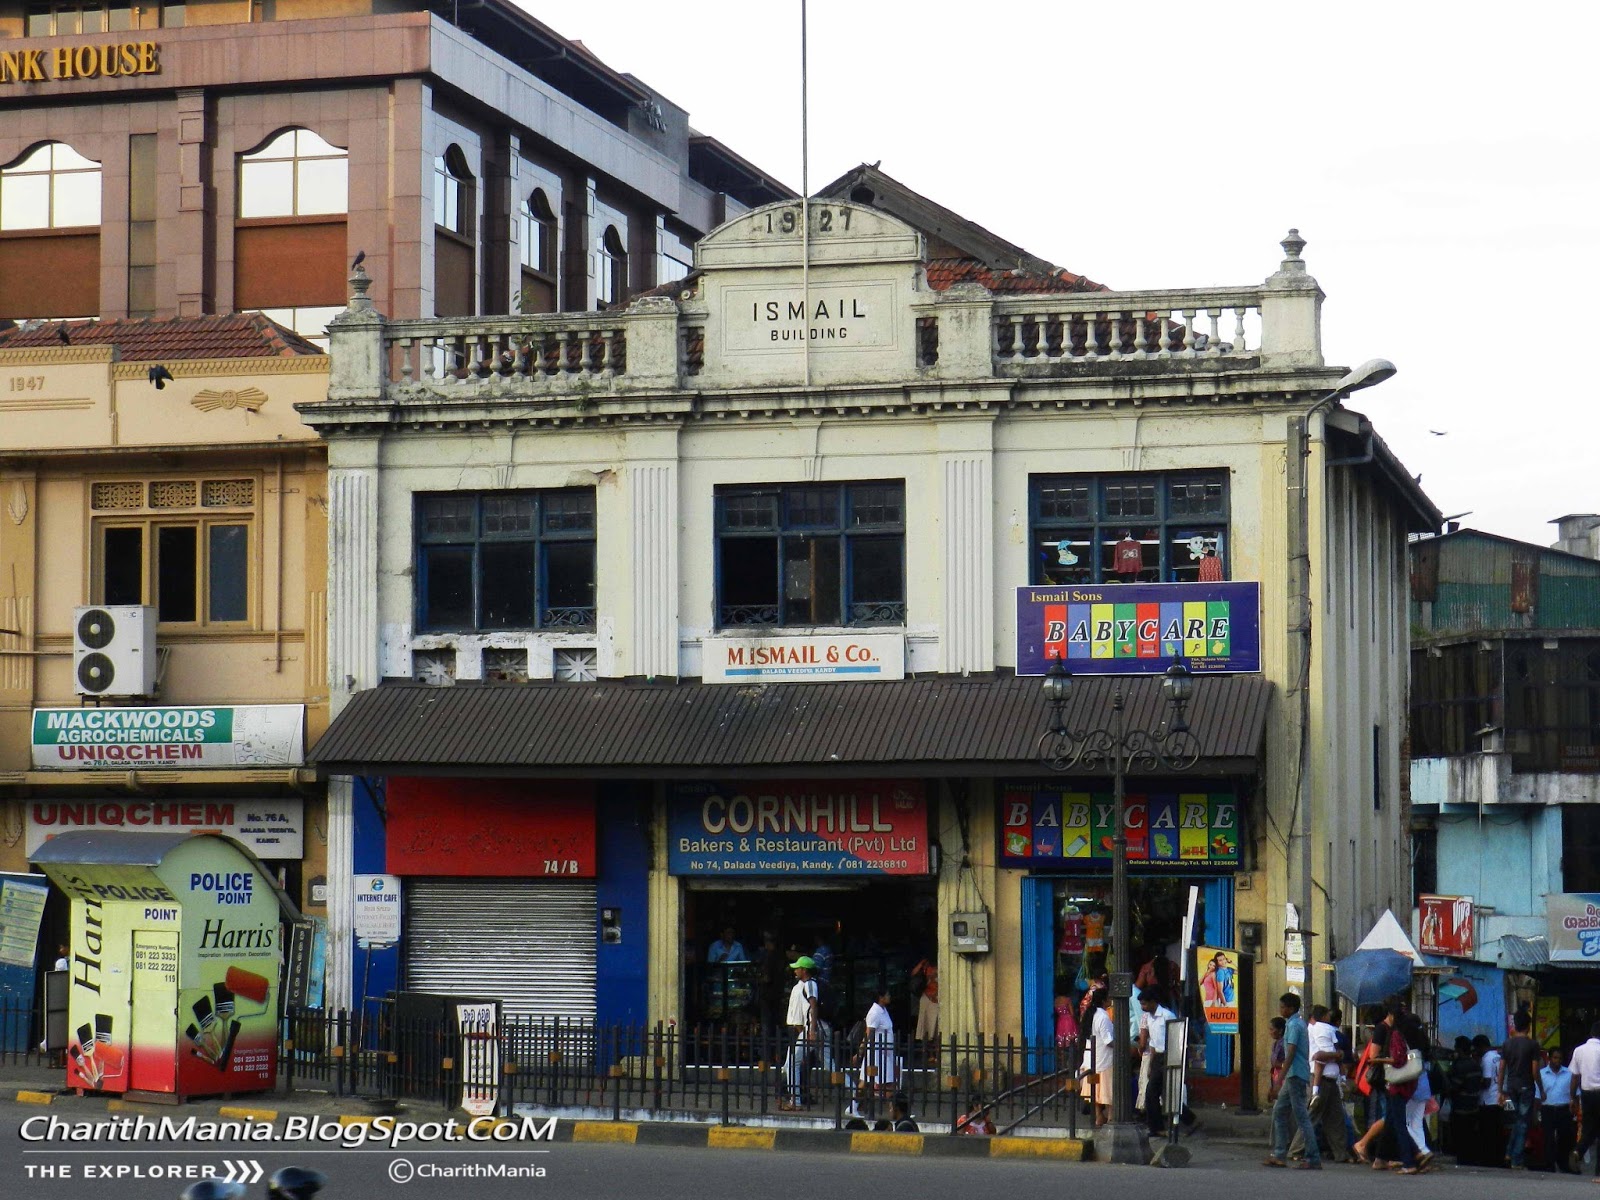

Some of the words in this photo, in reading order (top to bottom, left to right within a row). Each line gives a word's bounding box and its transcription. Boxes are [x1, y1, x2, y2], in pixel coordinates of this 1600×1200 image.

[53, 41, 157, 77] HOUSE
[766, 210, 853, 233] 1927
[753, 299, 866, 321] ISMAIL
[771, 328, 847, 341] BUILDING
[9, 376, 45, 392] 1947
[1031, 591, 1069, 603] Ismail
[1072, 590, 1102, 601] Sons
[1045, 617, 1229, 643] BABYCARE
[826, 645, 840, 663] &
[47, 711, 216, 729] MACKWOODS
[57, 729, 205, 743] AGROCHEMICALS
[58, 744, 203, 760] UNIQCHEM
[33, 803, 235, 826] UNIQCHEM
[247, 813, 263, 822] No.
[702, 794, 893, 834] CORNHILL
[680, 837, 733, 852] Bakers
[739, 837, 751, 852] &
[756, 837, 844, 852] Restaurant
[848, 837, 885, 855] (Pvt)
[891, 837, 916, 852] Ltd
[543, 860, 559, 874] 74
[569, 860, 578, 873] B
[691, 861, 703, 869] No
[706, 861, 721, 871] 74,
[724, 861, 756, 869] Dalada
[760, 861, 799, 871] Veediya,
[802, 860, 834, 871] Kandy.
[845, 860, 863, 869] 081
[867, 860, 907, 869] 2236810
[190, 873, 254, 892] POLICE
[92, 884, 176, 901] POLICE
[217, 893, 253, 905] POINT
[357, 894, 383, 902] INTERNET
[384, 894, 397, 902] CAFE
[144, 908, 178, 920] POINT
[1452, 899, 1471, 936] Viva
[199, 918, 274, 949] Harris
[148, 951, 160, 960] 223
[161, 952, 176, 961] 3333
[148, 962, 160, 971] 222
[161, 962, 176, 972] 2222
[164, 974, 176, 983] 119
